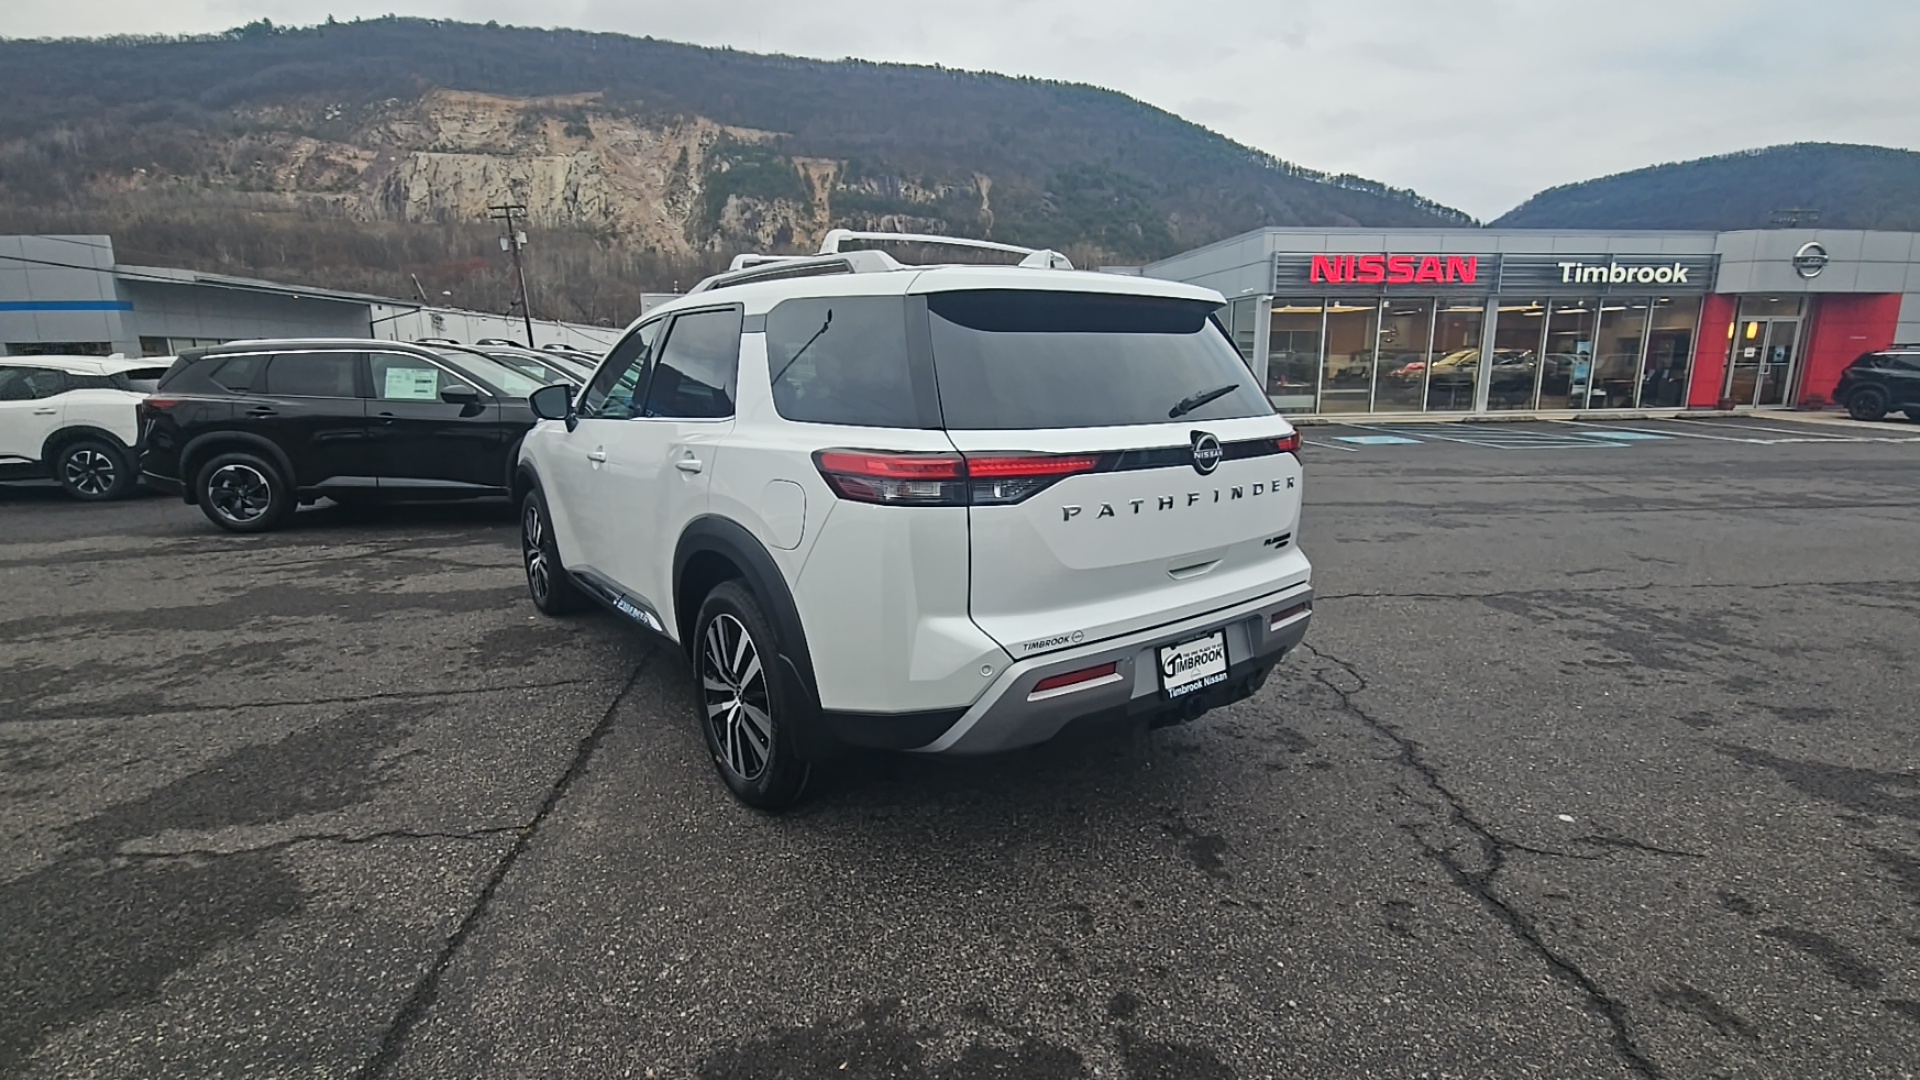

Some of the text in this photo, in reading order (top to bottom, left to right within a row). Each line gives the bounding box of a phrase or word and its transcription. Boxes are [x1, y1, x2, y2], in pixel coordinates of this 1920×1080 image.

[1310, 254, 1478, 284] NISSAN
[1557, 262, 1689, 283] Timbrook
[1193, 450, 1223, 459] NISSAN
[1062, 476, 1295, 521] PATHFINDER
[1023, 635, 1070, 651] TIMBROOK
[1163, 648, 1223, 678] TIMBROOK
[1168, 672, 1228, 699] Timbrook Nissan
